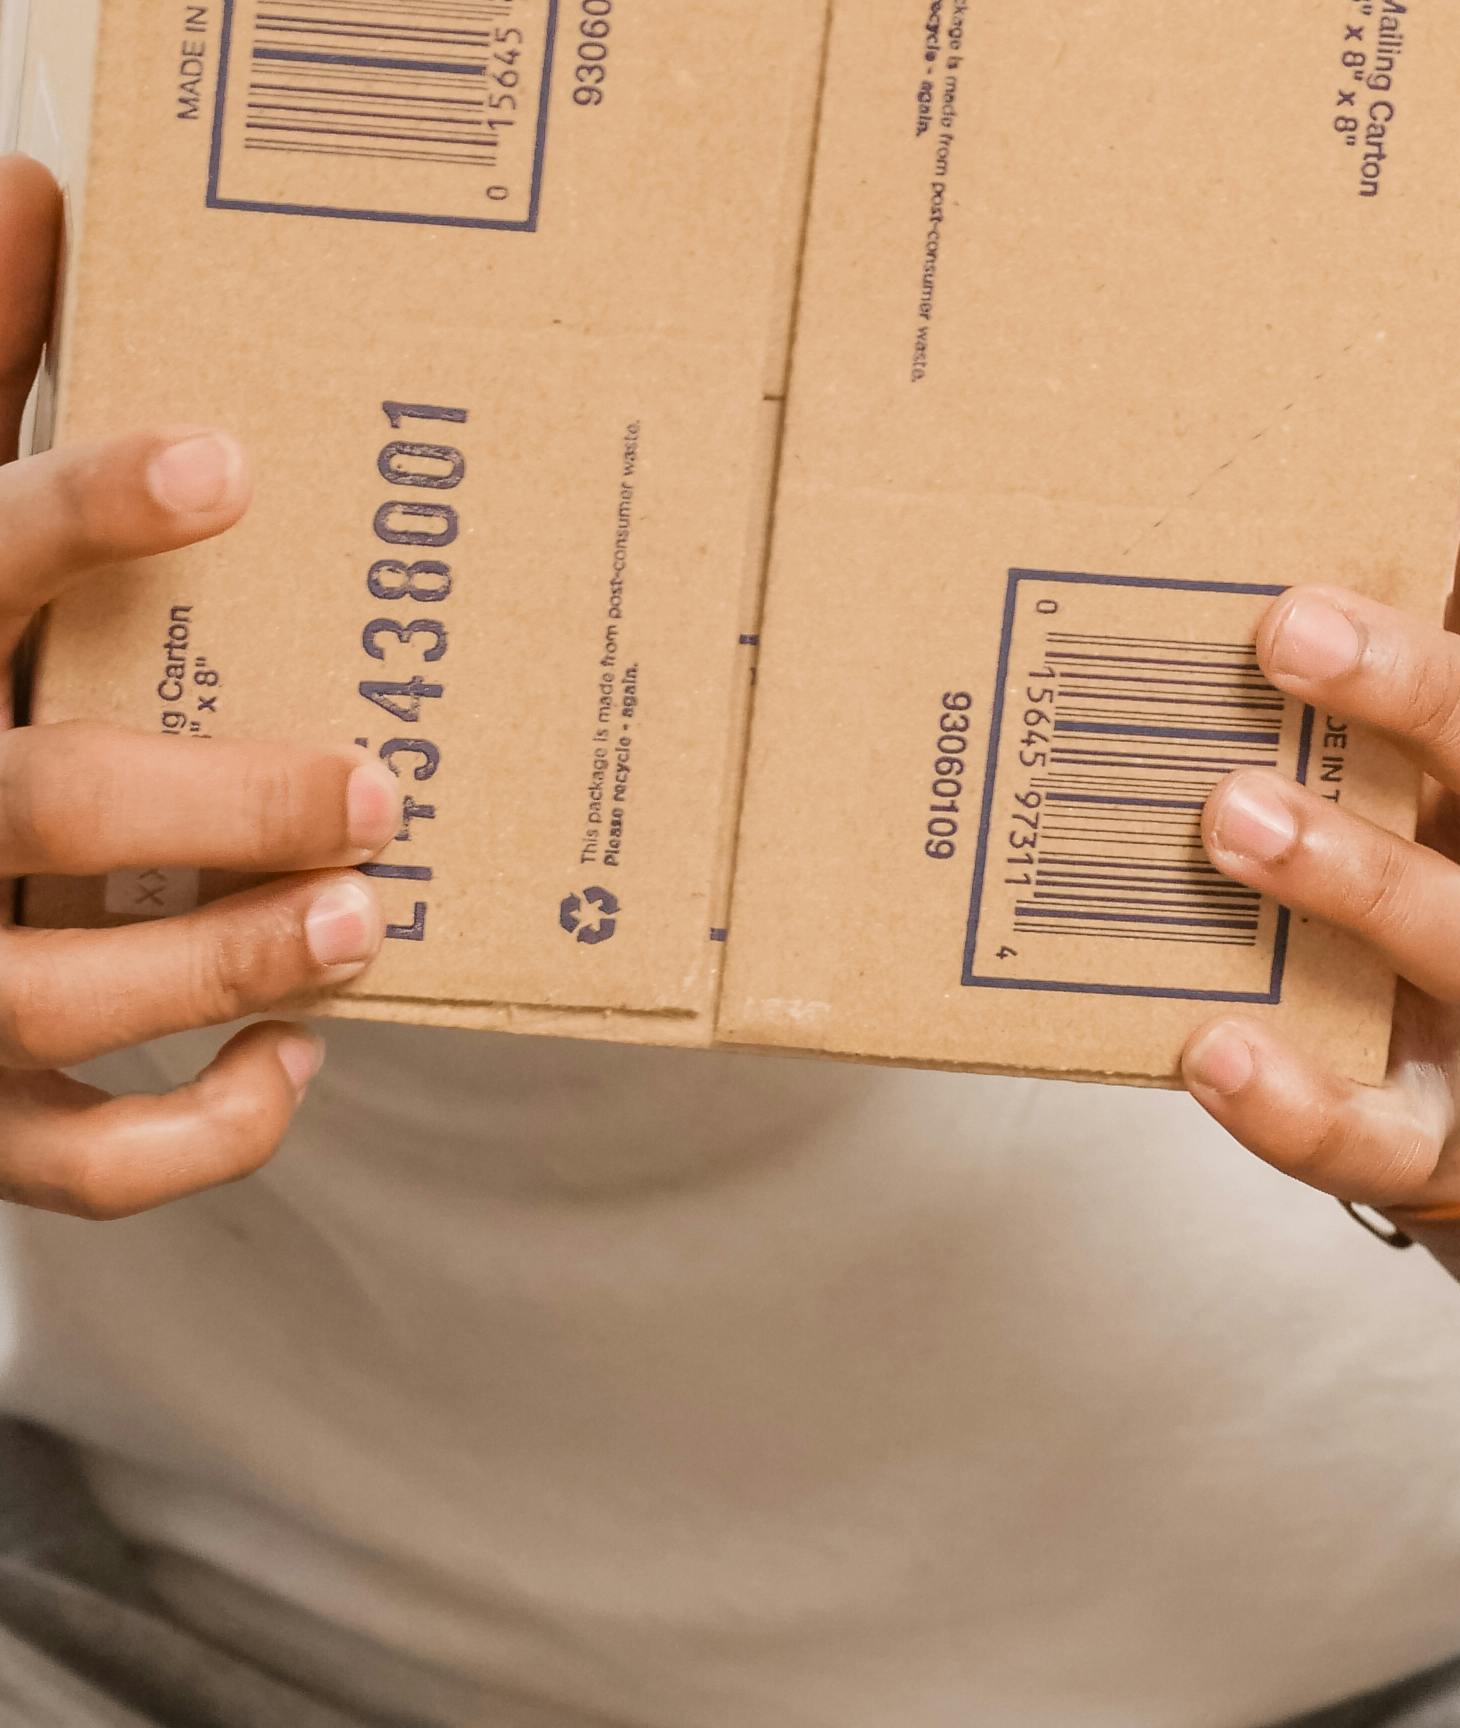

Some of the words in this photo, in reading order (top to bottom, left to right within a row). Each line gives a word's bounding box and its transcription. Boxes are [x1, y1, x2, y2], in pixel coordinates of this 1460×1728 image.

[185, 5, 208, 33] IN
[1344, 24, 1365, 42] x
[177, 39, 206, 120] MADE
[487, 26, 524, 131] 15645
[945, 54, 964, 70] is
[1341, 50, 1367, 81] 8"
[915, 80, 934, 137] again.
[940, 75, 958, 129] made
[1335, 89, 1357, 107] x
[936, 133, 954, 177] from
[1333, 115, 1359, 147] 8"
[1359, 100, 1395, 198] Carton
[486, 184, 510, 201] 0
[918, 181, 946, 321] post-consumer
[911, 325, 929, 383] waste.
[623, 420, 641, 477] waste.
[607, 482, 634, 619] post-consumer
[1035, 599, 1058, 616] 0
[157, 605, 193, 702] Carton
[194, 656, 220, 687] 8"
[600, 624, 619, 668] from
[197, 695, 217, 713] x
[598, 672, 616, 723] made
[622, 662, 640, 718] again.
[592, 728, 610, 742] is
[1018, 666, 1056, 768] 15645
[587, 747, 609, 824] package
[612, 735, 632, 802] recycle
[925, 690, 972, 860] 93060109
[1321, 756, 1345, 783] IN
[579, 828, 599, 865] This
[603, 807, 625, 867] Please
[1004, 790, 1042, 885] 97311
[995, 946, 1018, 960] 4
